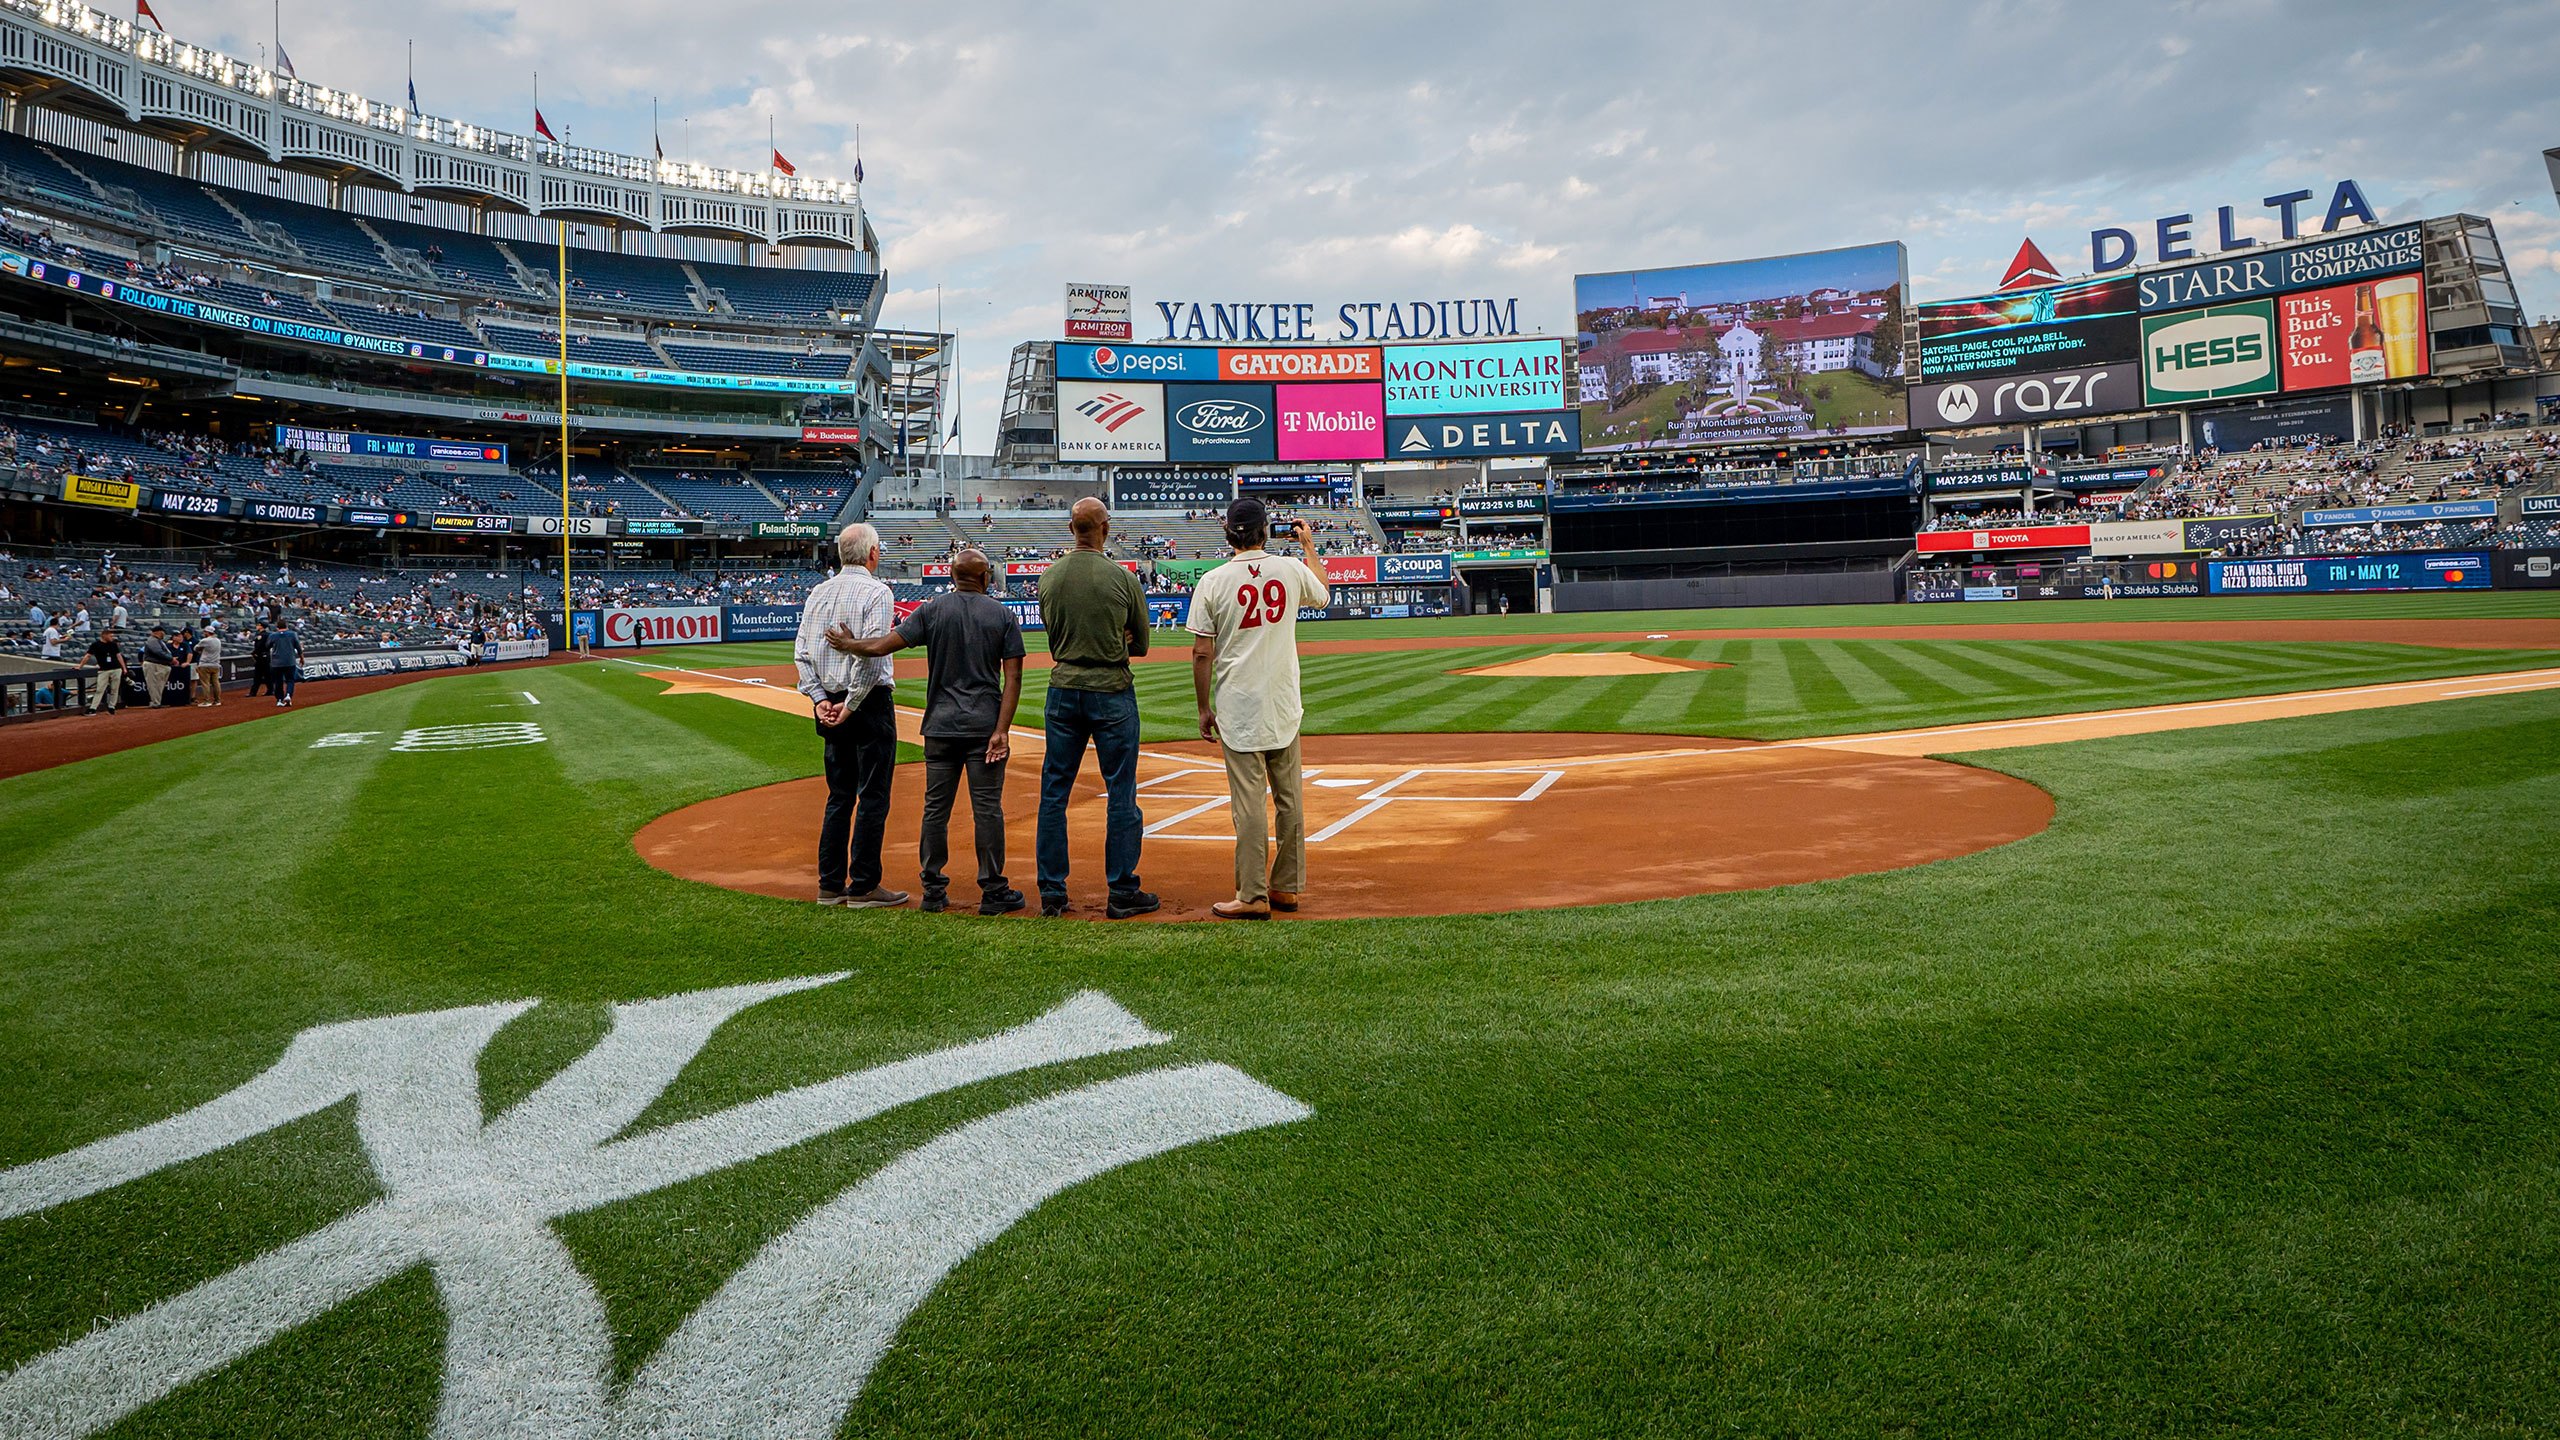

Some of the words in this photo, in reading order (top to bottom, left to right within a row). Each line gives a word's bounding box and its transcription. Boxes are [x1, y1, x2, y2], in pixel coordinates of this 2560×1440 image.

[2091, 179, 2379, 273] DELTA
[2290, 228, 2421, 268] INSURANCE
[2291, 246, 2421, 284] COMPANIES
[2140, 260, 2275, 307] STARR
[1069, 289, 1128, 300] ARMITRON
[2286, 296, 2331, 316] This
[120, 286, 168, 311] FOLLOW
[171, 300, 196, 316] THE
[199, 305, 250, 328] YANKEES
[252, 317, 270, 332] ON
[273, 321, 341, 344] INSTAGRAM
[343, 334, 405, 354] @YANKEES
[1073, 322, 1126, 332] ARMITRON
[1155, 301, 1315, 341] YANKEE
[1339, 298, 1520, 340] STADIUM
[1922, 345, 1960, 356] SATCHEL
[1962, 341, 1990, 353] PAIGE,
[1991, 338, 2015, 349] COOL
[2018, 335, 2040, 345] PAPA
[2043, 331, 2067, 342] BELL,
[2289, 335, 2322, 350] For
[1922, 356, 1941, 366] AND
[1943, 348, 2000, 363] PATTERSON'S
[2003, 347, 2025, 357] OWN
[2027, 342, 2056, 354] LARRY
[2058, 339, 2086, 350] DOBY.
[2155, 333, 2262, 373] HESS
[2288, 352, 2333, 367] You.
[1123, 353, 1184, 374] pepsi
[1230, 353, 1370, 374] GATORADE
[1388, 355, 1560, 382] MONTCLAIR
[1923, 365, 1944, 375] NOW
[1946, 364, 1953, 372] A
[1954, 362, 1974, 372] NEW
[1977, 358, 2016, 369] MUSEUM
[1388, 384, 1440, 401] STATE
[1451, 380, 1562, 399] UNIVERSITY
[1994, 371, 2108, 416] razr
[502, 412, 528, 421] Audi
[529, 413, 562, 424] YANKEES
[566, 414, 583, 425] CLUB
[1192, 405, 1249, 430] Ford
[1306, 411, 1376, 432] Mobile
[1668, 421, 1685, 430] Run
[1688, 420, 1698, 430] by
[1700, 417, 1741, 428] Montclair
[1744, 416, 1766, 425] State
[1769, 413, 1814, 424] University
[286, 428, 303, 439] STAR
[328, 432, 349, 442] NIGHT
[820, 432, 857, 440] Budweiser
[1443, 421, 1567, 448] DELTA
[1678, 432, 1687, 440] in
[1690, 428, 1740, 441] partnership
[1743, 427, 1762, 435] with
[1765, 425, 1804, 434] Paterson
[2291, 433, 2320, 444] BOSS
[306, 440, 350, 453] BOBBLEHEAD
[367, 440, 380, 451] FRI
[387, 441, 404, 454] MAY
[406, 442, 416, 455] 12
[1061, 442, 1091, 450] BANK
[1095, 442, 1108, 450] OF
[1112, 442, 1162, 450] AMERICA
[1192, 437, 1250, 445] BuyFordNow.com
[433, 448, 479, 457] yankees.com
[382, 456, 430, 470] LANDING
[1936, 477, 1956, 486] MAY
[1957, 475, 1983, 484] 23-25
[2001, 471, 2023, 481] BAL
[162, 494, 184, 509] MAY
[187, 497, 218, 513] 23-25
[1462, 501, 1480, 510] MAY
[1481, 501, 1502, 509] 23-25
[1517, 499, 1535, 508] BAL
[2091, 496, 2122, 504] TOYOTA
[269, 505, 315, 520] ORIOLES
[2324, 512, 2356, 520] FANDUEL
[2382, 509, 2416, 517] FANDUEL
[2444, 506, 2480, 514] FANDUEL
[435, 518, 474, 526] ARMITRON
[477, 518, 493, 528] 6:51
[543, 518, 591, 533] ORIS
[759, 523, 789, 535] Poland
[790, 523, 820, 536] Spring
[1991, 534, 2029, 543] TOYOTA
[1403, 559, 1443, 573] coupa
[2223, 565, 2244, 577] STAR
[2277, 563, 2304, 575] NIGHT
[2330, 566, 2347, 580] FRI
[2358, 565, 2383, 580] MAY
[2386, 564, 2400, 579] 12
[2427, 560, 2477, 569] yankees.com
[2222, 576, 2246, 588] RIZZO
[2249, 575, 2307, 588] BOBBLEHEAD
[2084, 587, 2121, 596] Stubub
[2124, 586, 2160, 595] StubHub
[2162, 585, 2198, 594] StubHub
[1238, 579, 1287, 630] 29
[732, 612, 793, 624] Montefiore
[606, 612, 718, 642] Canon
[483, 646, 496, 656] ACC
[133, 681, 185, 691] StHub
